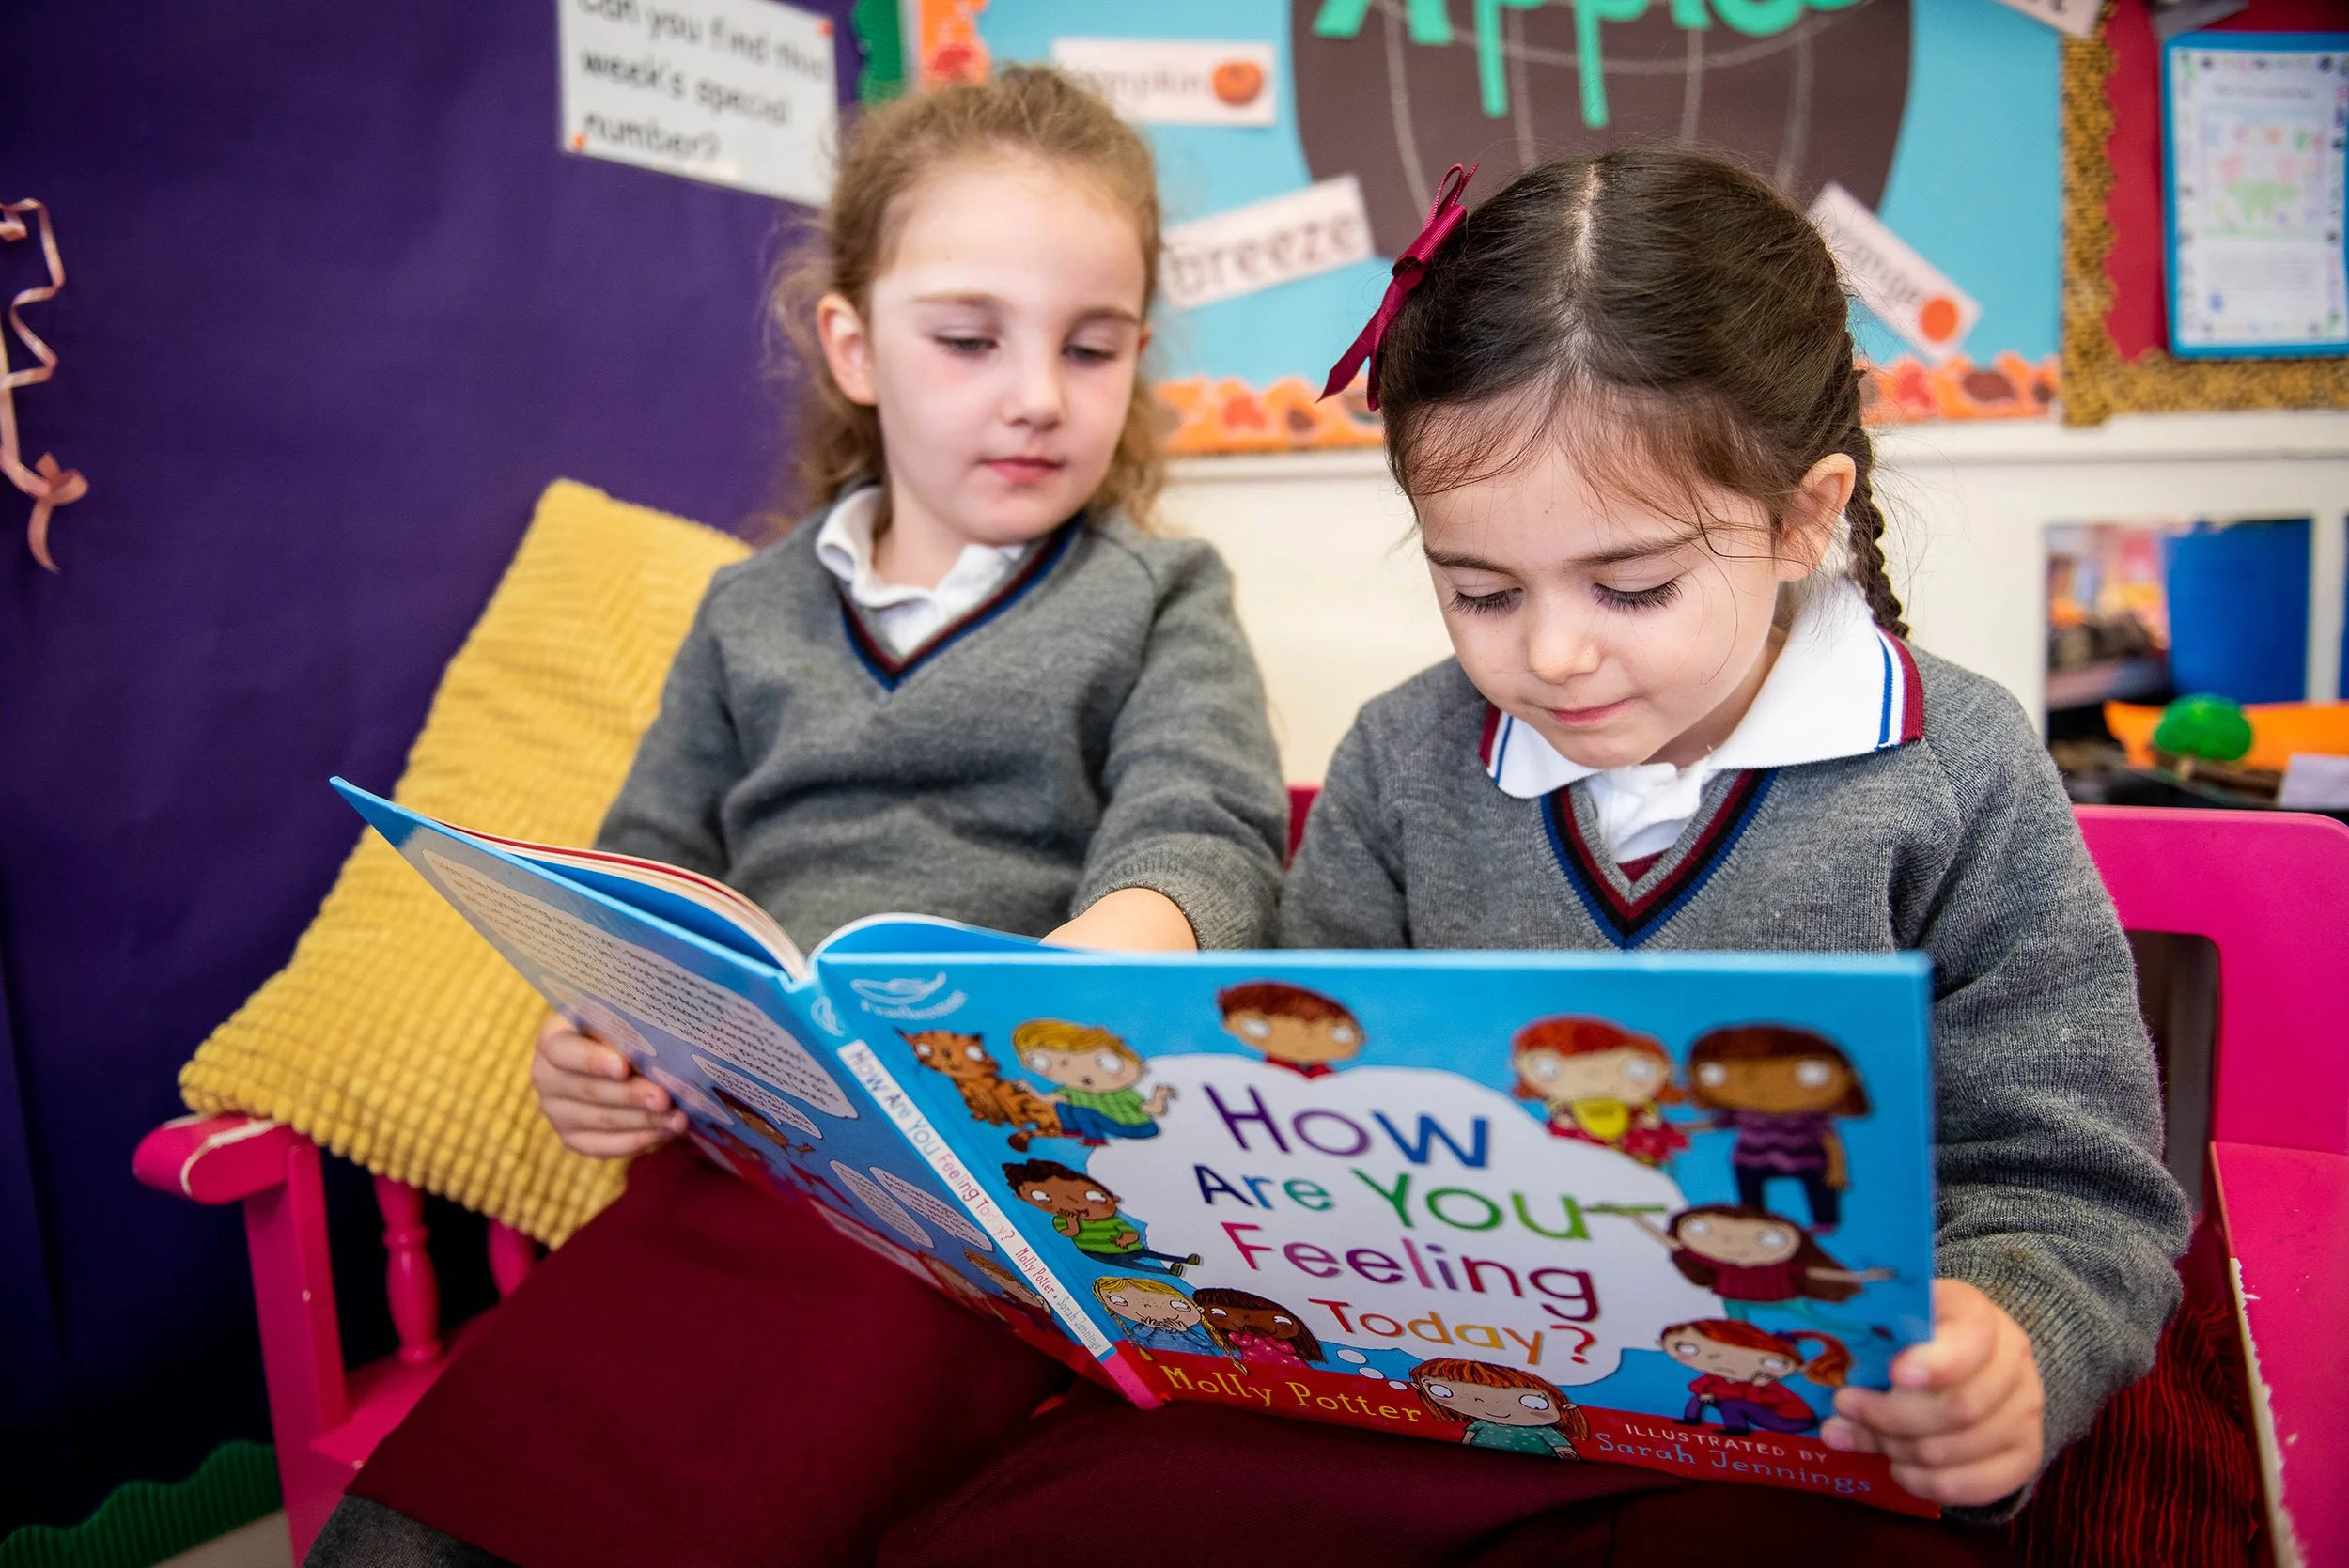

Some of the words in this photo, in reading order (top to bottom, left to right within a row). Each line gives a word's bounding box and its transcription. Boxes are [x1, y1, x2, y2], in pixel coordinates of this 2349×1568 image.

[646, 6, 703, 44] you
[709, 16, 769, 64] find
[580, 49, 687, 101] week's
[694, 77, 789, 127] special
[581, 110, 720, 160] number?
[1165, 215, 1356, 294] breeze
[1203, 1082, 1490, 1170] How
[1193, 1163, 1335, 1211] Are
[1349, 1167, 1592, 1242] You
[1015, 1246, 1037, 1273] Molly
[1032, 1266, 1055, 1294] Potter
[1056, 1296, 1080, 1321] Sarah
[1074, 1316, 1102, 1350] Jennings
[1221, 1220, 1600, 1323] Feeling
[1307, 1297, 1595, 1366] Today?
[1159, 1365, 1272, 1407] Molly
[1284, 1381, 1422, 1422] Potter
[1595, 1432, 1697, 1465] Sarah
[1708, 1449, 1872, 1494] Jennings
[1625, 1423, 1786, 1457] ILLUSTRATED
[1798, 1450, 1828, 1463] BY
